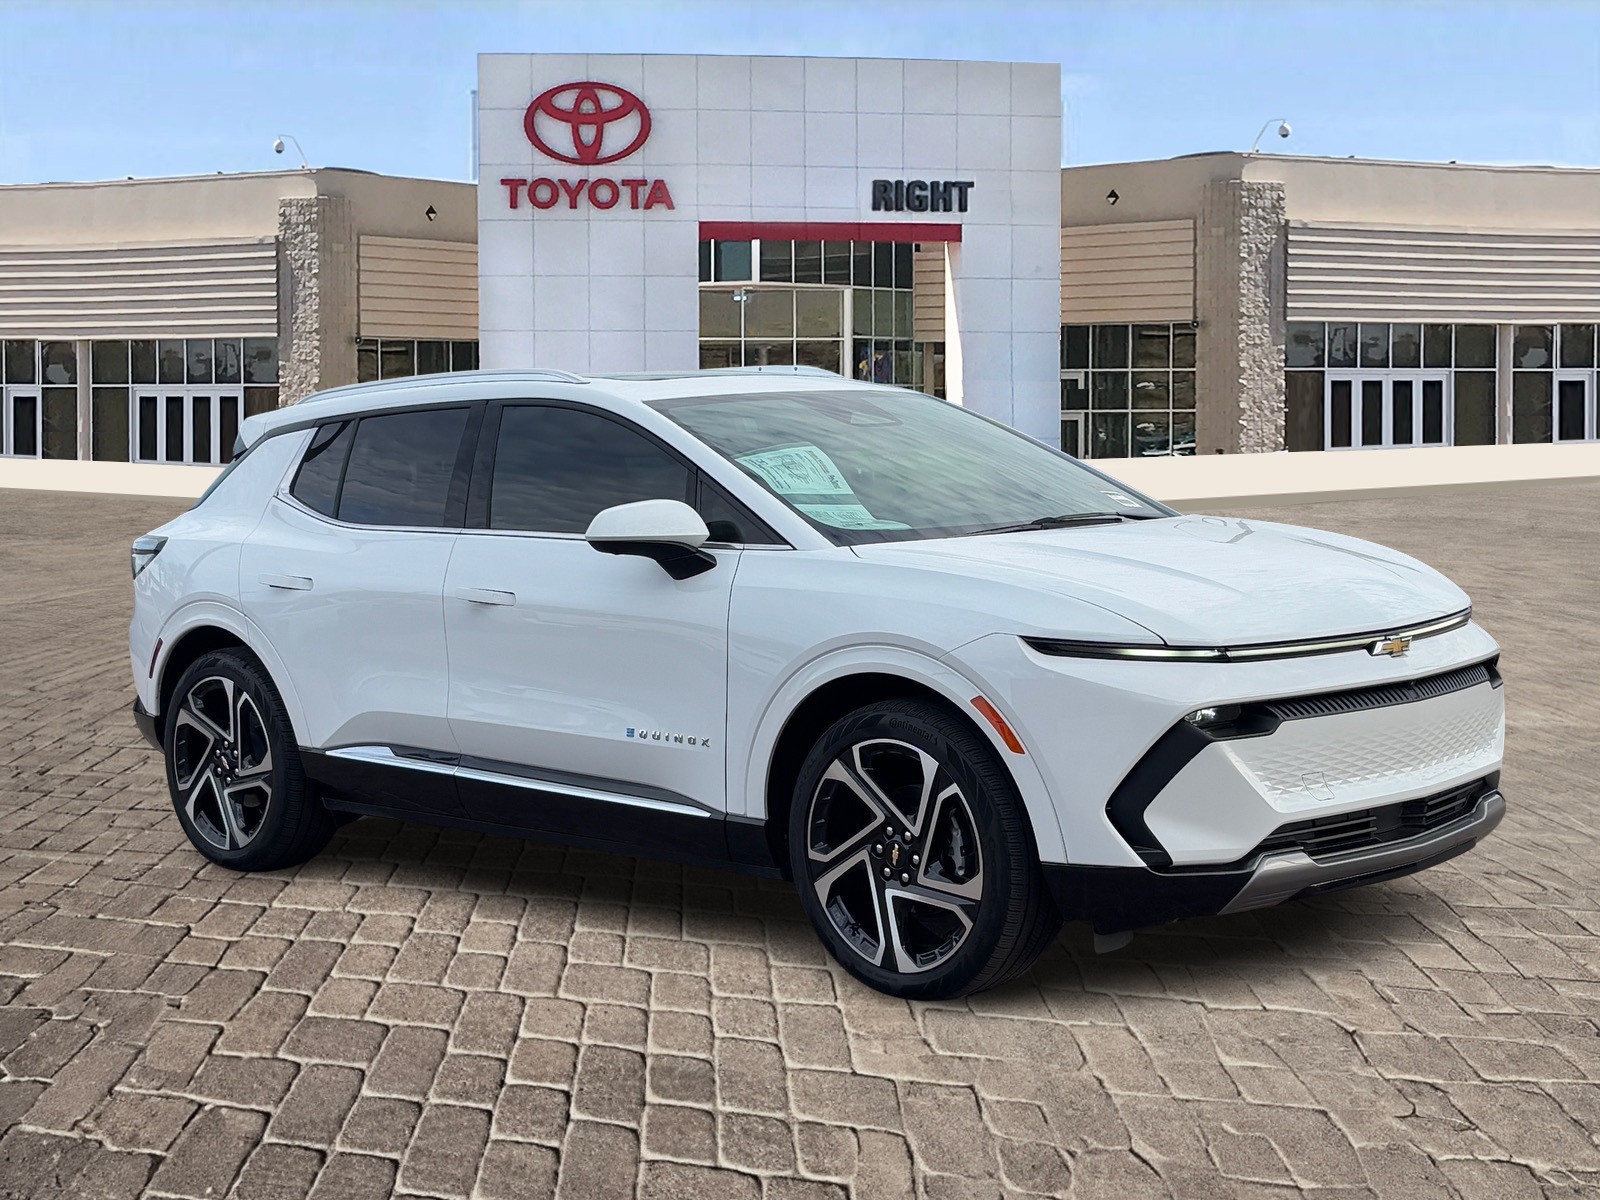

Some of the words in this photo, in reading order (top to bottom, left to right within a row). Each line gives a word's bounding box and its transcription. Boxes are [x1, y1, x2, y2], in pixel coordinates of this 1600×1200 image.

[500, 178, 675, 210] TOYOTA
[872, 180, 975, 212] RIGHT
[626, 727, 710, 748] EQUINOX
[889, 717, 934, 742] Continental
